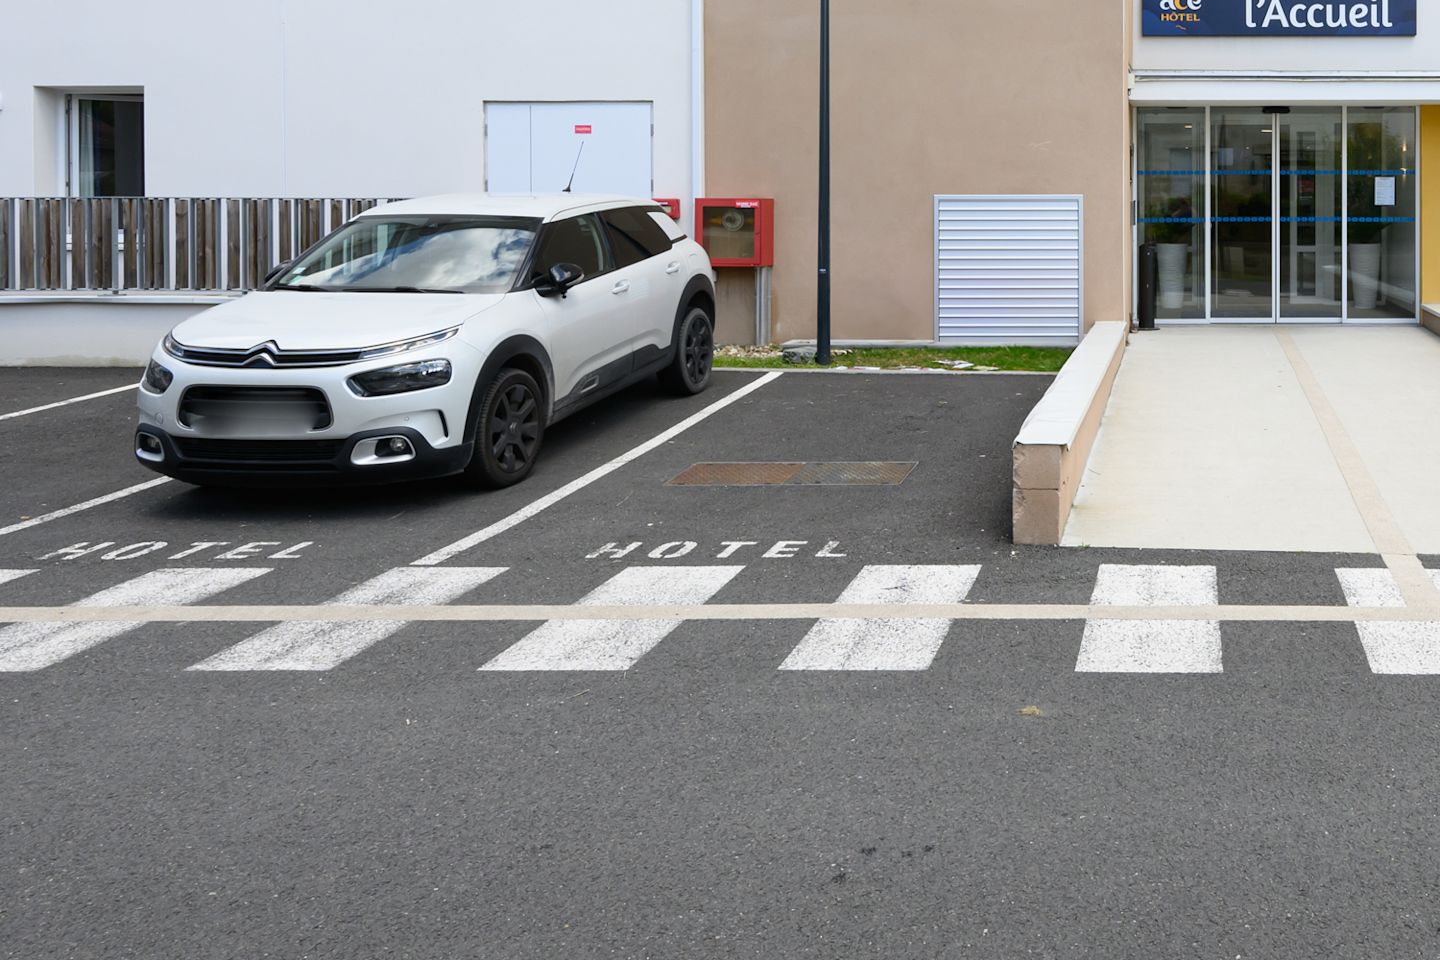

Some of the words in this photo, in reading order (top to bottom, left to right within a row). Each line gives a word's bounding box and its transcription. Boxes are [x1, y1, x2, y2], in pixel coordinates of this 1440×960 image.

[1160, 11, 1201, 22] HÔTEL
[35, 541, 315, 561] HOTEL
[584, 540, 848, 559] HOTEL
